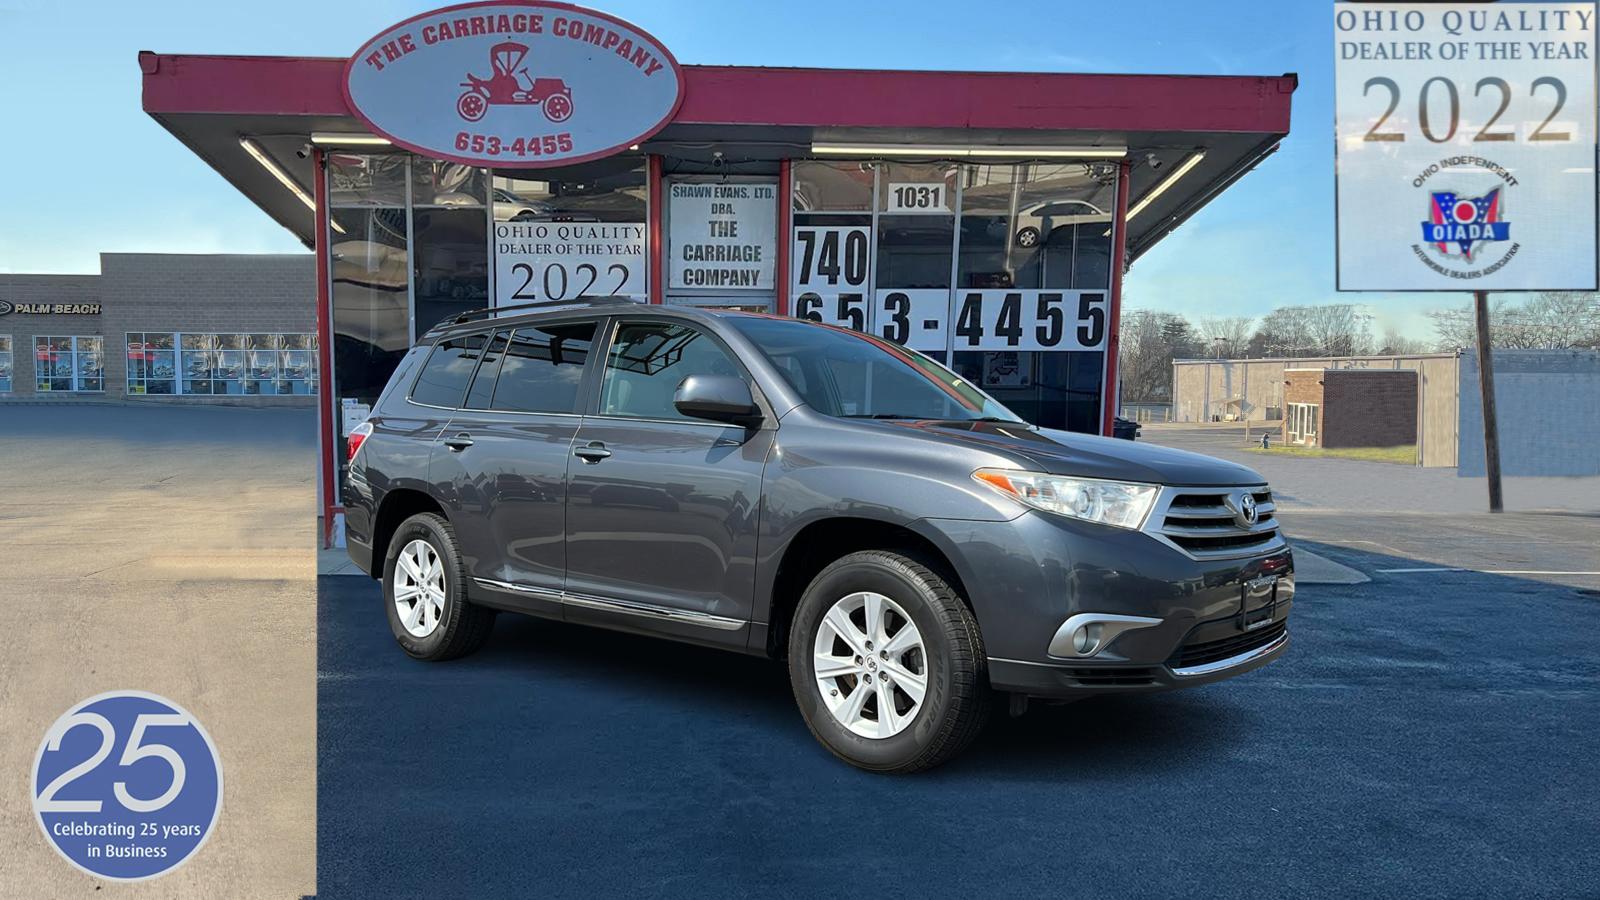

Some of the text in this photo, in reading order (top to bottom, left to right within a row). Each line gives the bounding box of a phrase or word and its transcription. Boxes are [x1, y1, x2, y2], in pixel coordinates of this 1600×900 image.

[1336, 9, 1593, 36] OHIO QUALITY
[366, 14, 663, 76] THE CARRIAGE COMPANY
[1340, 41, 1589, 60] DEALER OF THE YEAR
[1362, 75, 1571, 143] 2022
[455, 132, 573, 157] 653-4455
[1412, 155, 1519, 188] OHIO INDEPENDENT
[673, 186, 711, 198] SHAWN
[754, 187, 775, 199] LTD.
[894, 186, 940, 208] 1031
[711, 203, 736, 215] DBA.
[497, 226, 645, 243] OHIO QUALITY
[708, 221, 738, 238] THE
[1432, 224, 1495, 240] OIADA
[499, 243, 641, 255] DEALER OF THE YEAR
[683, 244, 763, 263] CARRIAGE
[798, 230, 867, 286] 740
[1411, 242, 1521, 280] AUTOMOBILE DEALERS ASSOCIATION
[511, 262, 631, 300] 2022
[683, 268, 761, 287] COMPANY
[14, 303, 100, 314] PALM BEACH
[796, 292, 1105, 347] 653-4455
